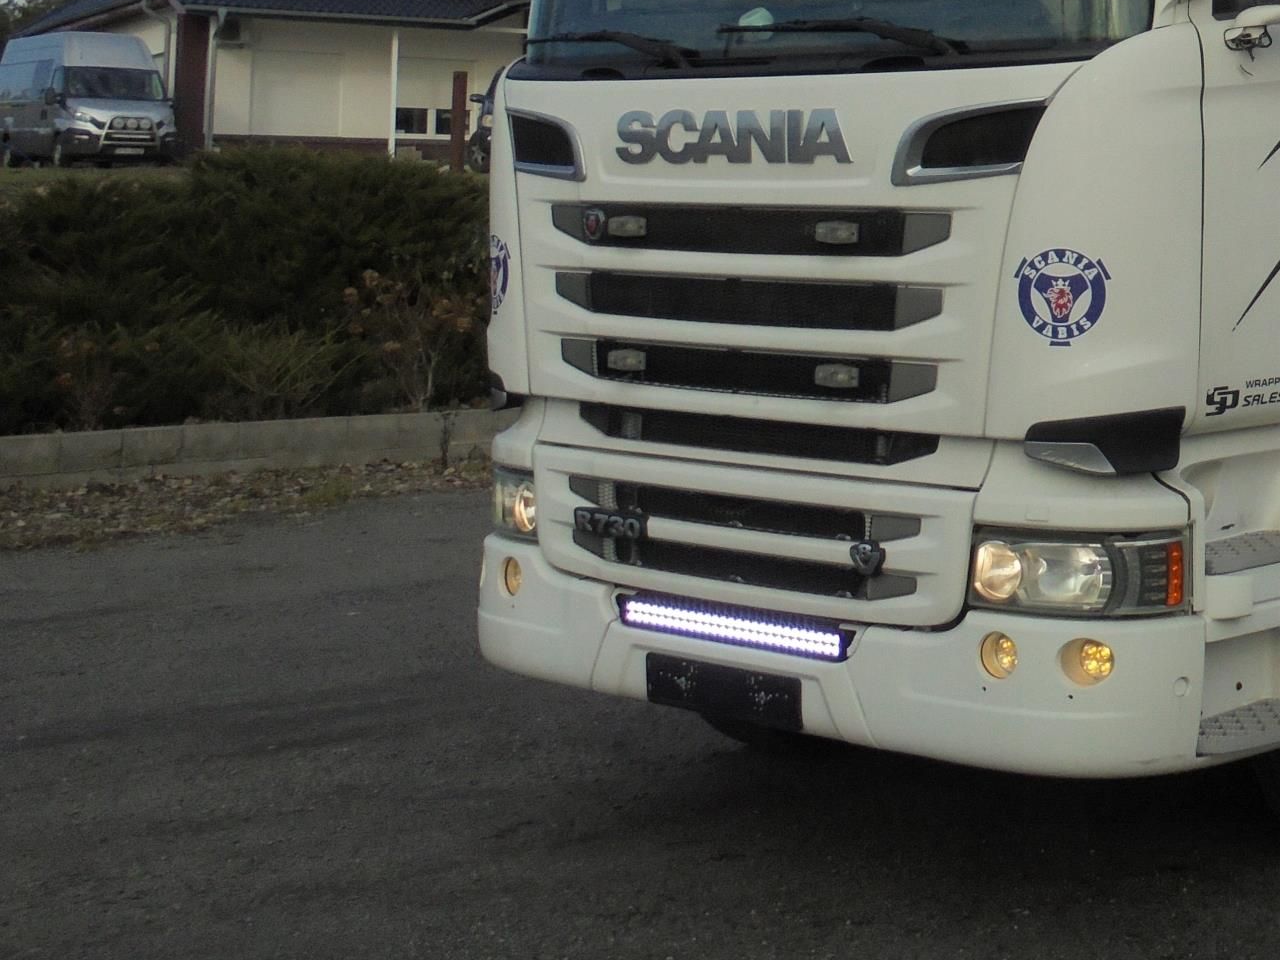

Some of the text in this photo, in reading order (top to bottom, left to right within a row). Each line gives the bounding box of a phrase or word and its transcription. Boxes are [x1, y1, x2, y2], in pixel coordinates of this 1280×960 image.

[615, 108, 854, 164] SCANIA
[1023, 250, 1099, 281] SCANIA
[1031, 315, 1092, 339] VABIS
